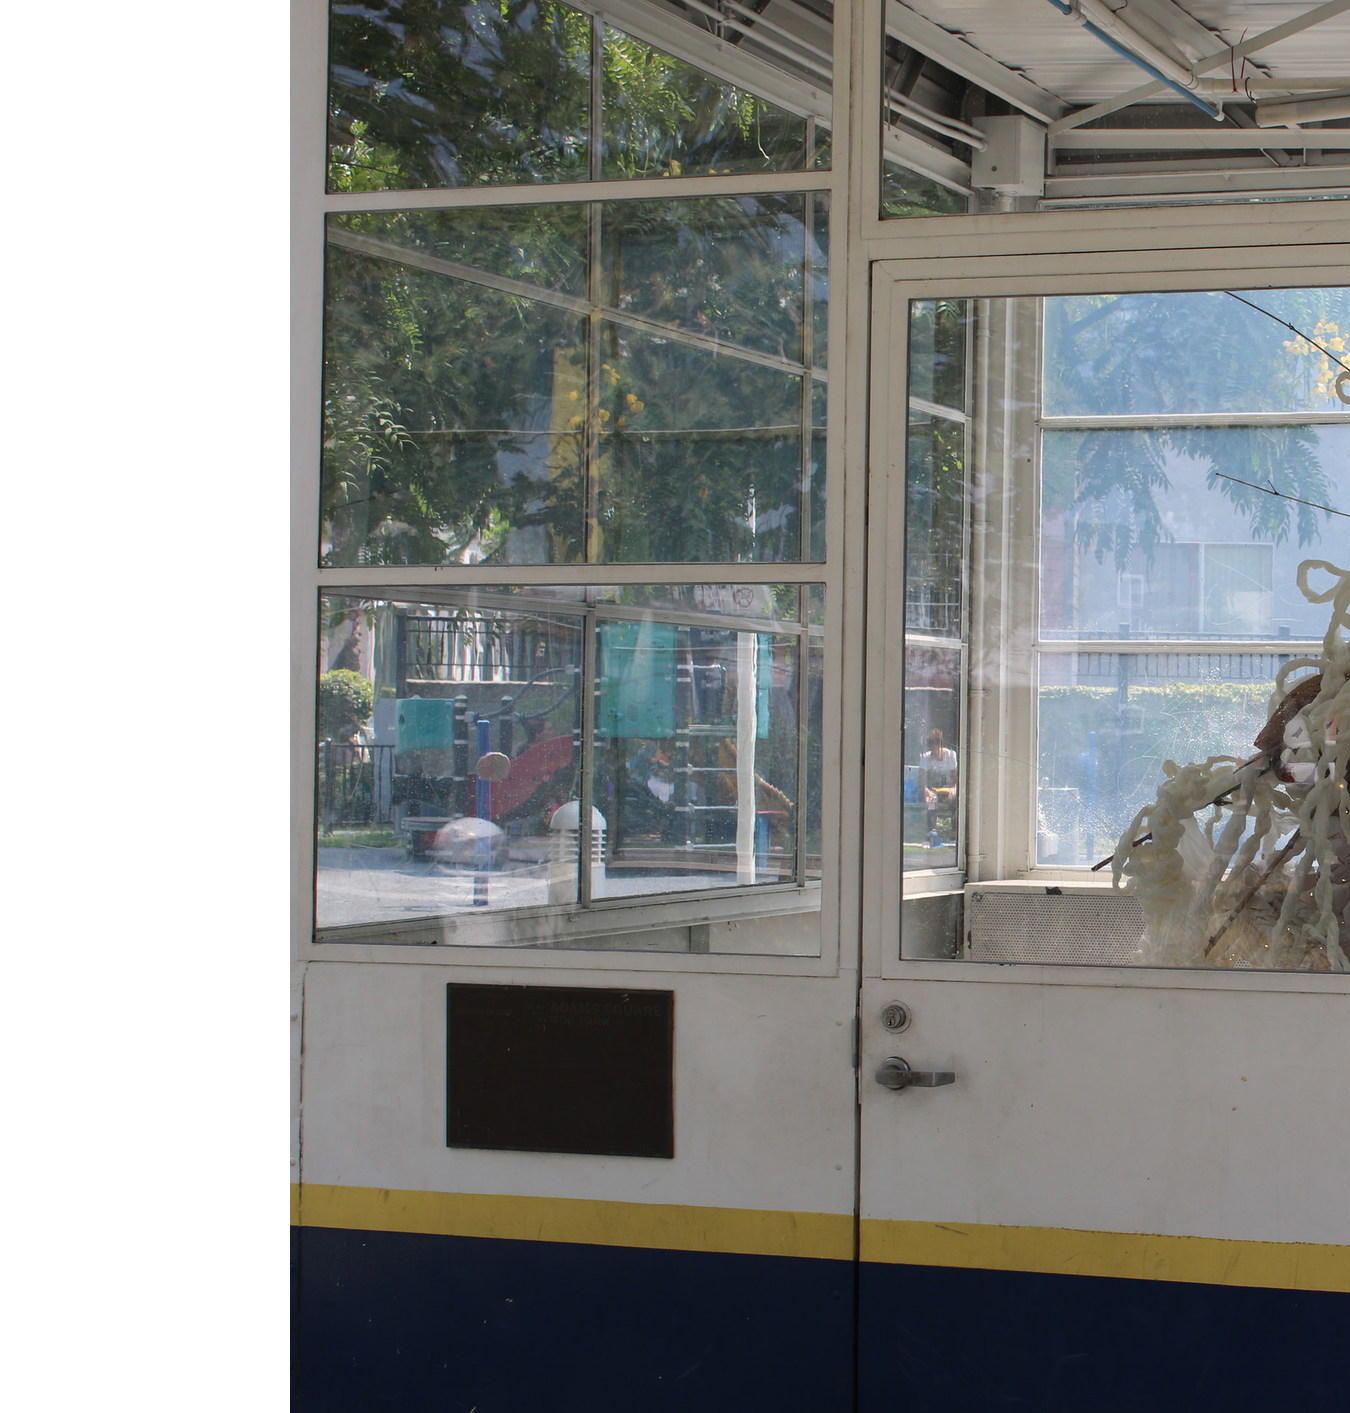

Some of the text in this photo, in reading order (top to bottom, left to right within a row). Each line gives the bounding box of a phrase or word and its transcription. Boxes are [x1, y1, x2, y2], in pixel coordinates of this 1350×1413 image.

[550, 1001, 662, 1018] ADAMS SQUARE
[549, 1015, 610, 1027] MINI PARK
